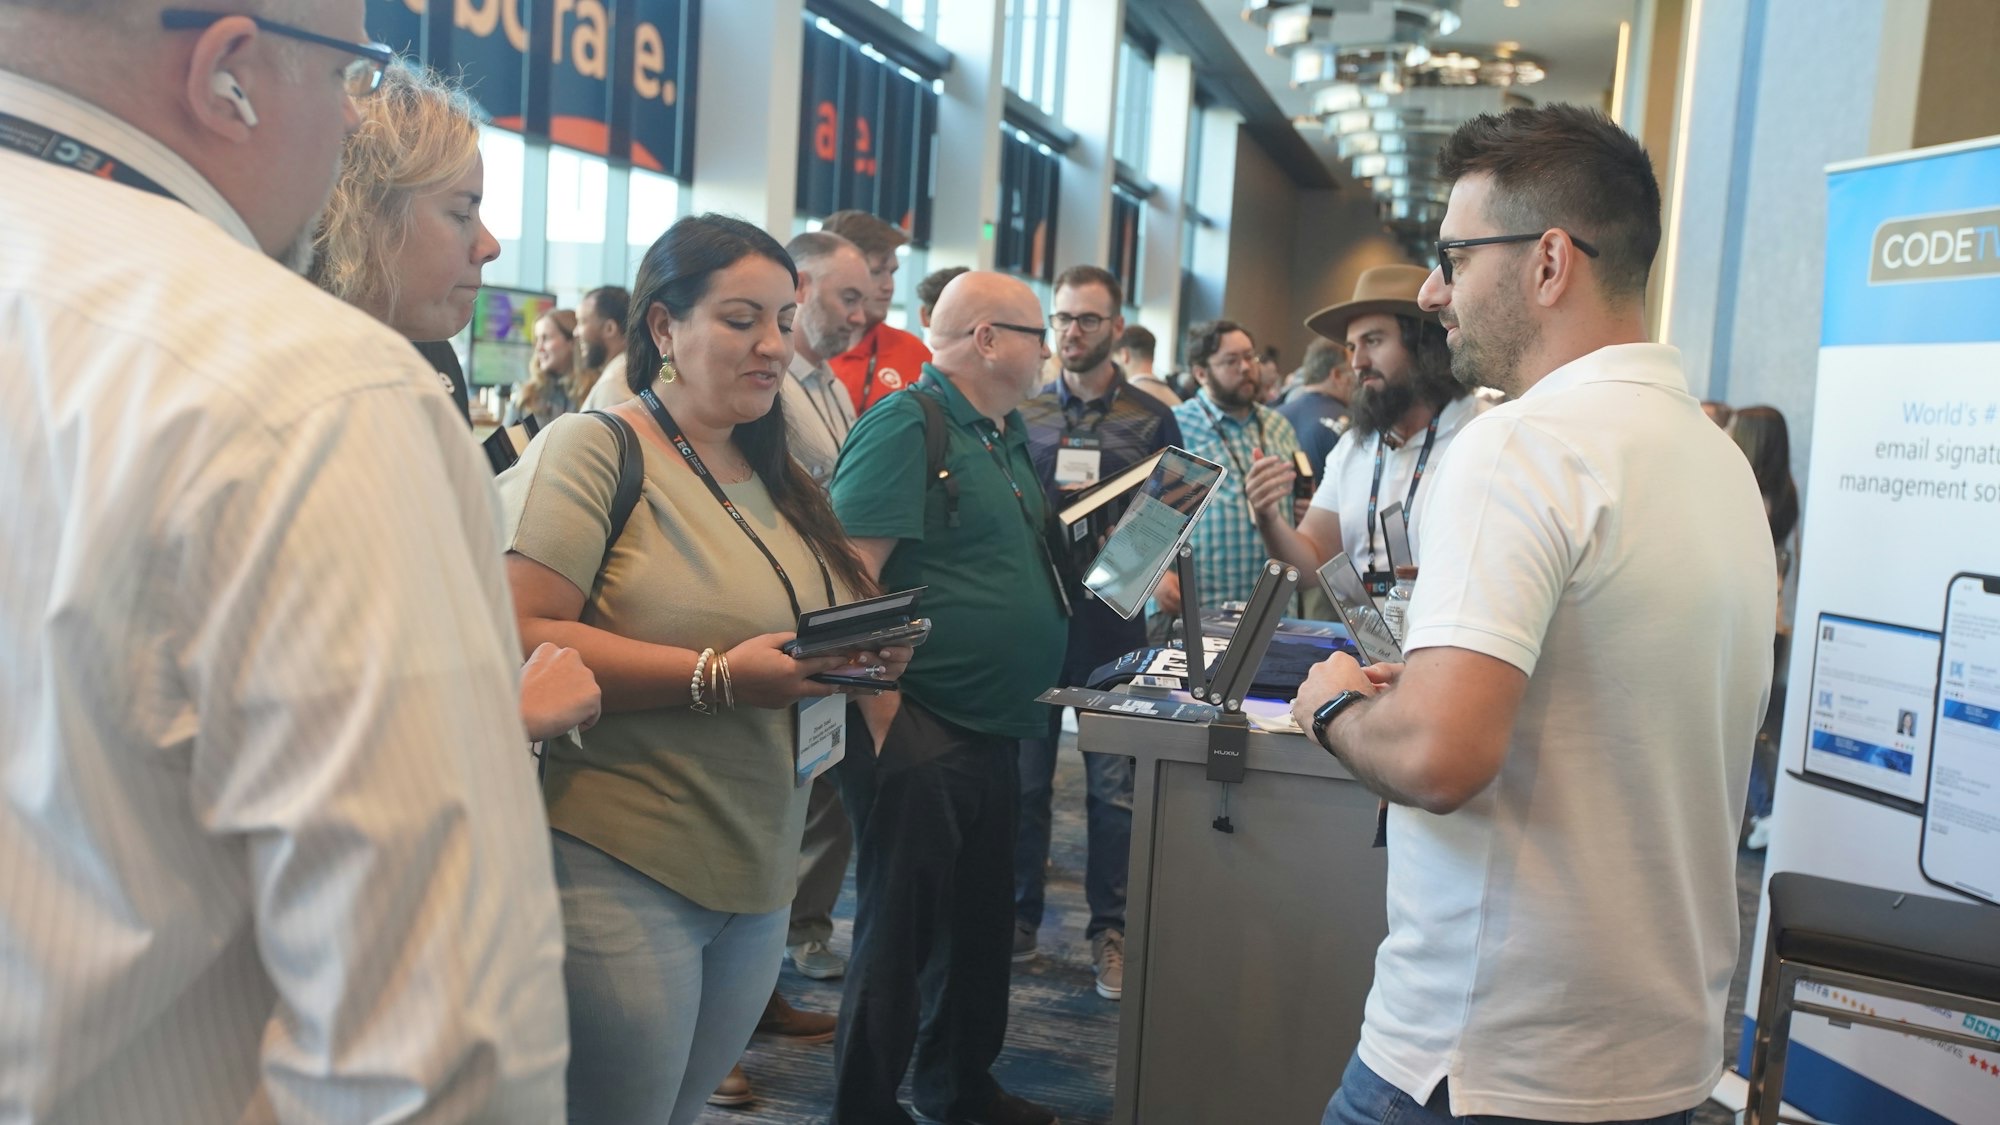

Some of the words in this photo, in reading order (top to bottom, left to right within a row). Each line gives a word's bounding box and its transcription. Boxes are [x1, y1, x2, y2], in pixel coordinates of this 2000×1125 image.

[1903, 401, 1977, 426] World's
[673, 434, 692, 456] TEC
[1875, 437, 1930, 461] email
[1839, 473, 1967, 502] management
